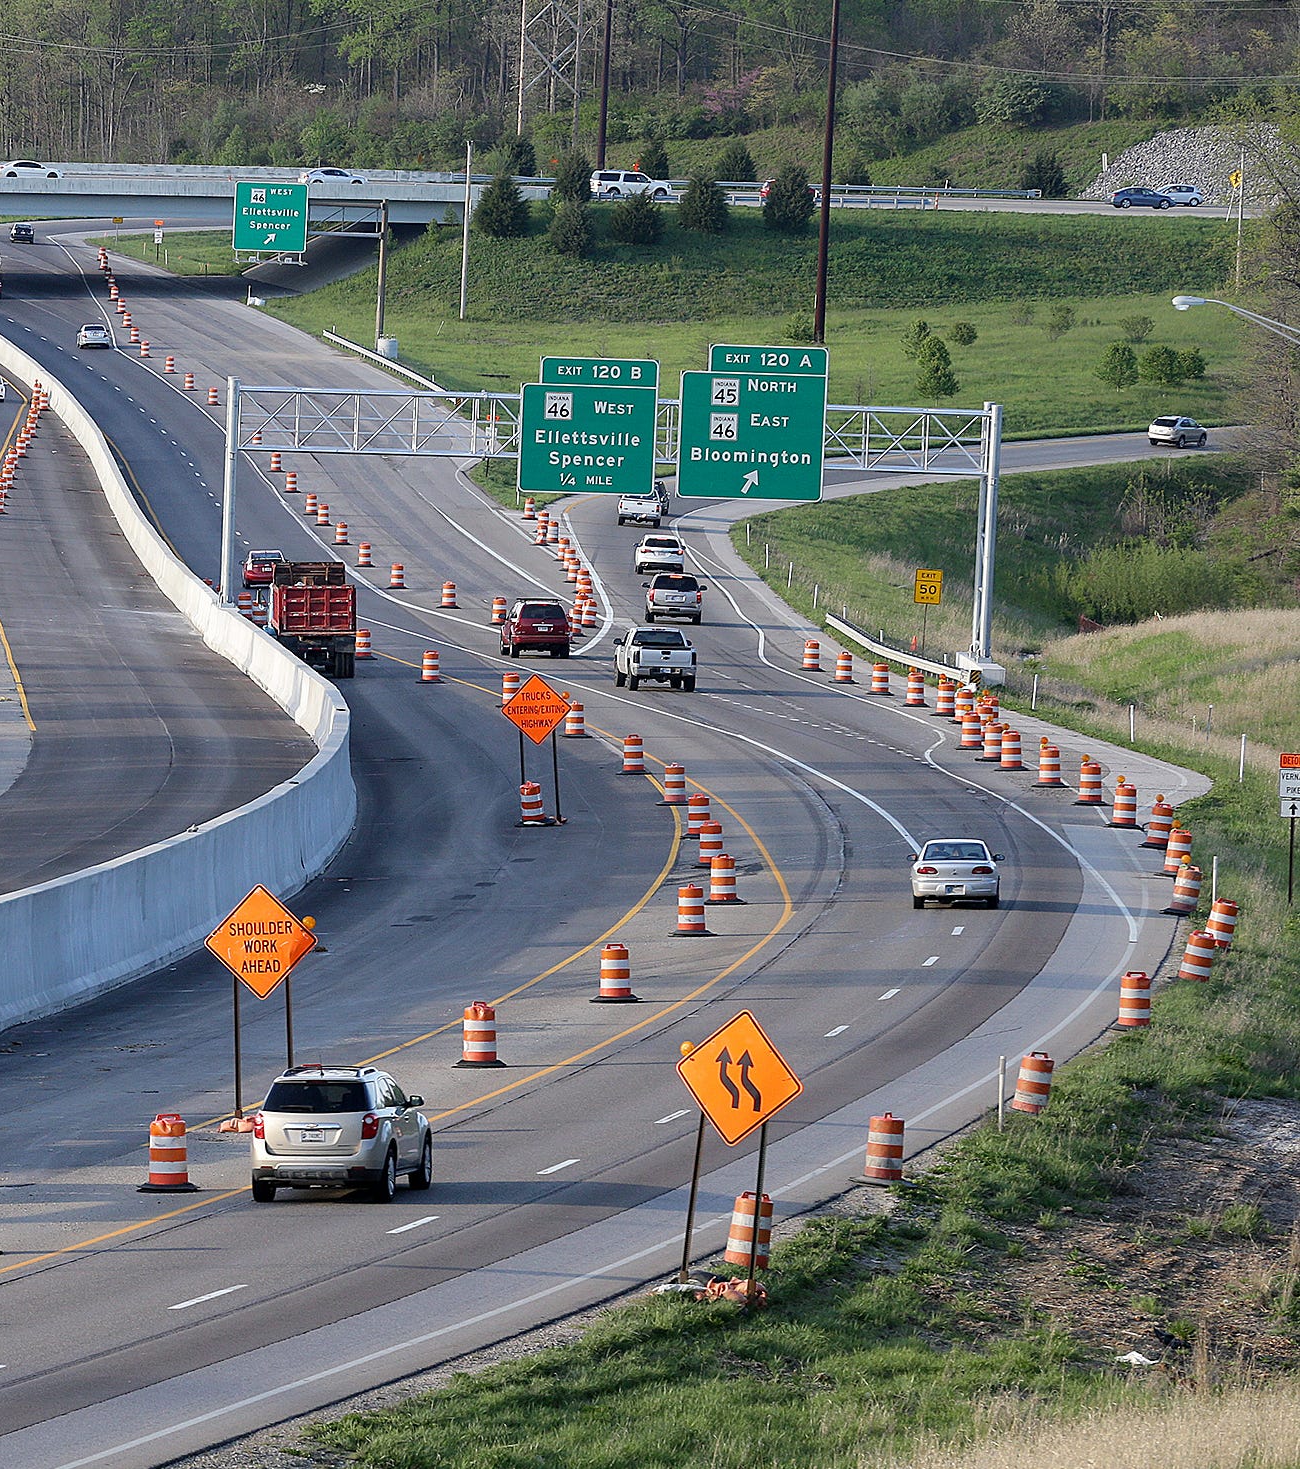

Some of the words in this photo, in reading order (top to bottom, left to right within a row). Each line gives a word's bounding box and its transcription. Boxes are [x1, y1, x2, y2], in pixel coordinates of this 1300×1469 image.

[252, 193, 265, 202] 46
[269, 188, 293, 196] WEST
[242, 207, 300, 217] Ellettsville
[249, 221, 291, 230] Spencer
[725, 354, 750, 364] EXIT
[760, 353, 789, 367] 120
[799, 355, 812, 368] A
[557, 366, 583, 376] EXIT
[592, 365, 621, 379] 120
[630, 366, 642, 380] B
[714, 389, 737, 404] 45
[547, 402, 570, 418] 46
[535, 429, 641, 447] Ellettsville
[712, 423, 735, 439] 46
[549, 451, 625, 468] Spencer
[691, 447, 811, 468] Bloomington
[586, 476, 613, 486] MILE
[919, 584, 937, 595] 50
[521, 691, 551, 701] TRUCKS
[507, 705, 566, 715] ENTERING/EXITING
[521, 719, 554, 728] HIGHWAY
[229, 921, 293, 936] SHOULDER
[244, 940, 278, 953] WORK
[241, 960, 281, 973] AHEAD
